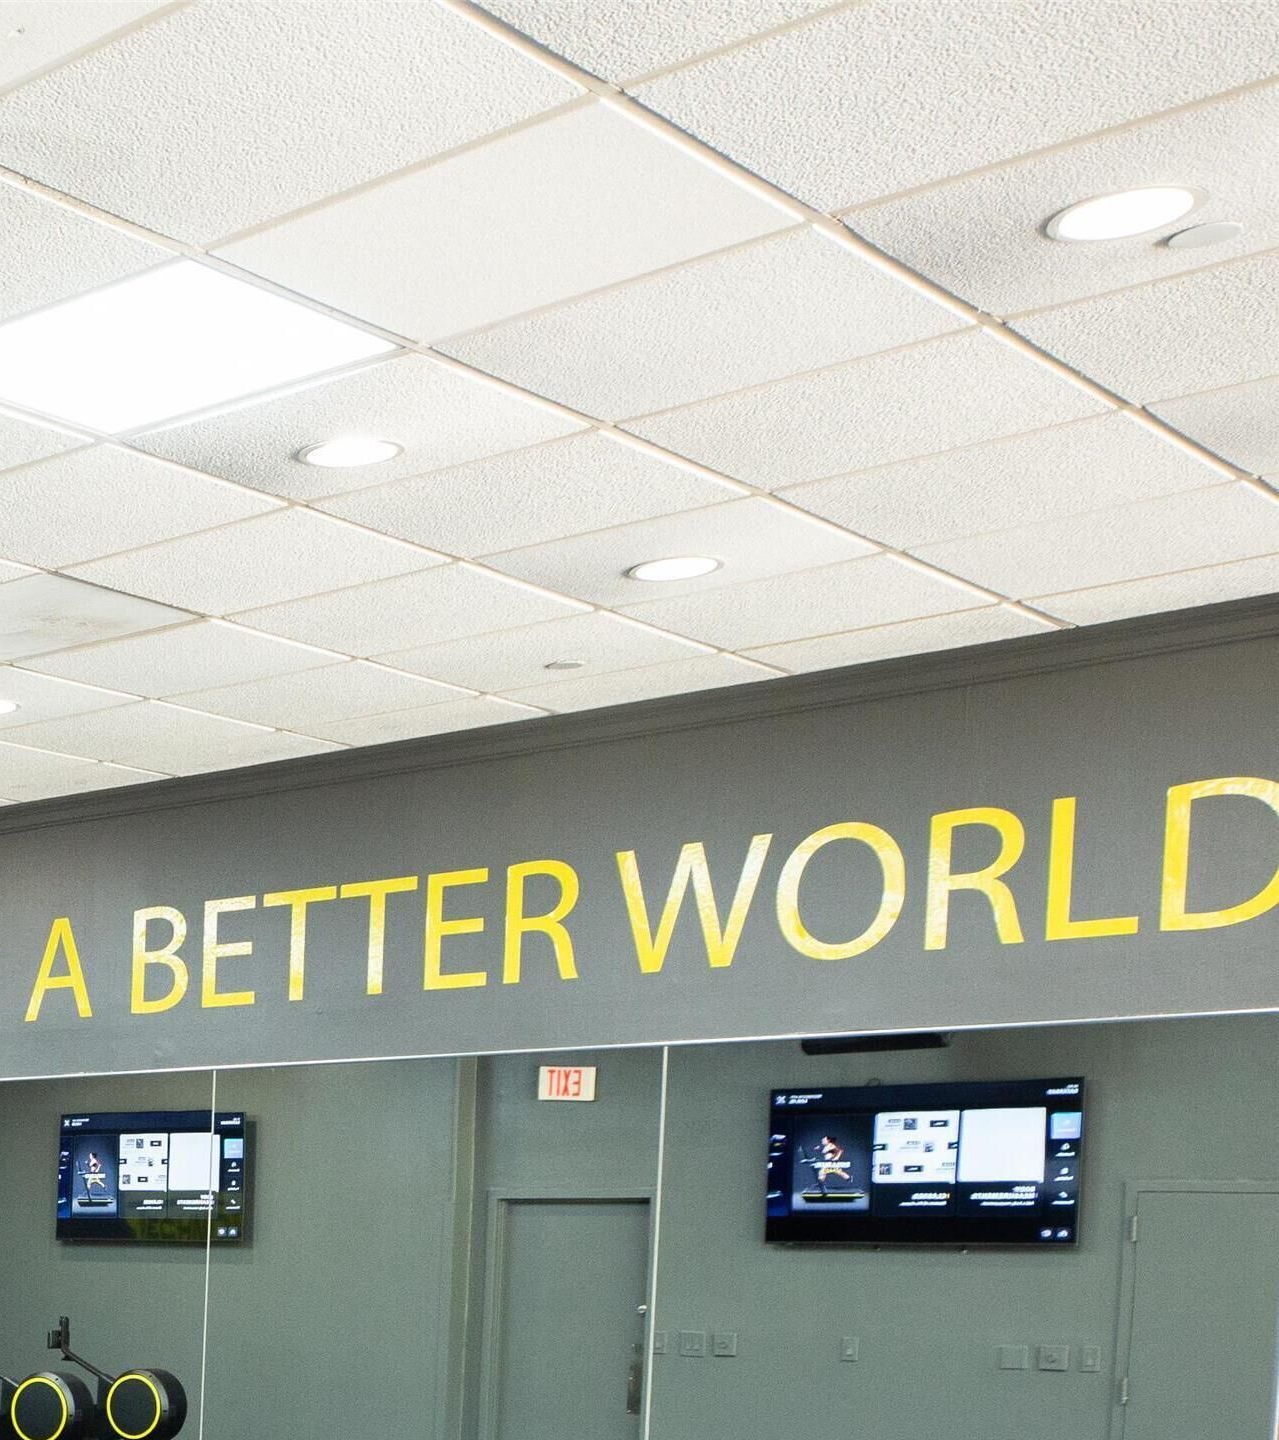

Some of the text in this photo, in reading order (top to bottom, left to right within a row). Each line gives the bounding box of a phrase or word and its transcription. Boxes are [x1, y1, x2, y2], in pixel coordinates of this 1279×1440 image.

[25, 916, 93, 1023] A
[130, 859, 580, 1015] BETTER
[616, 776, 1279, 974] WORLD
